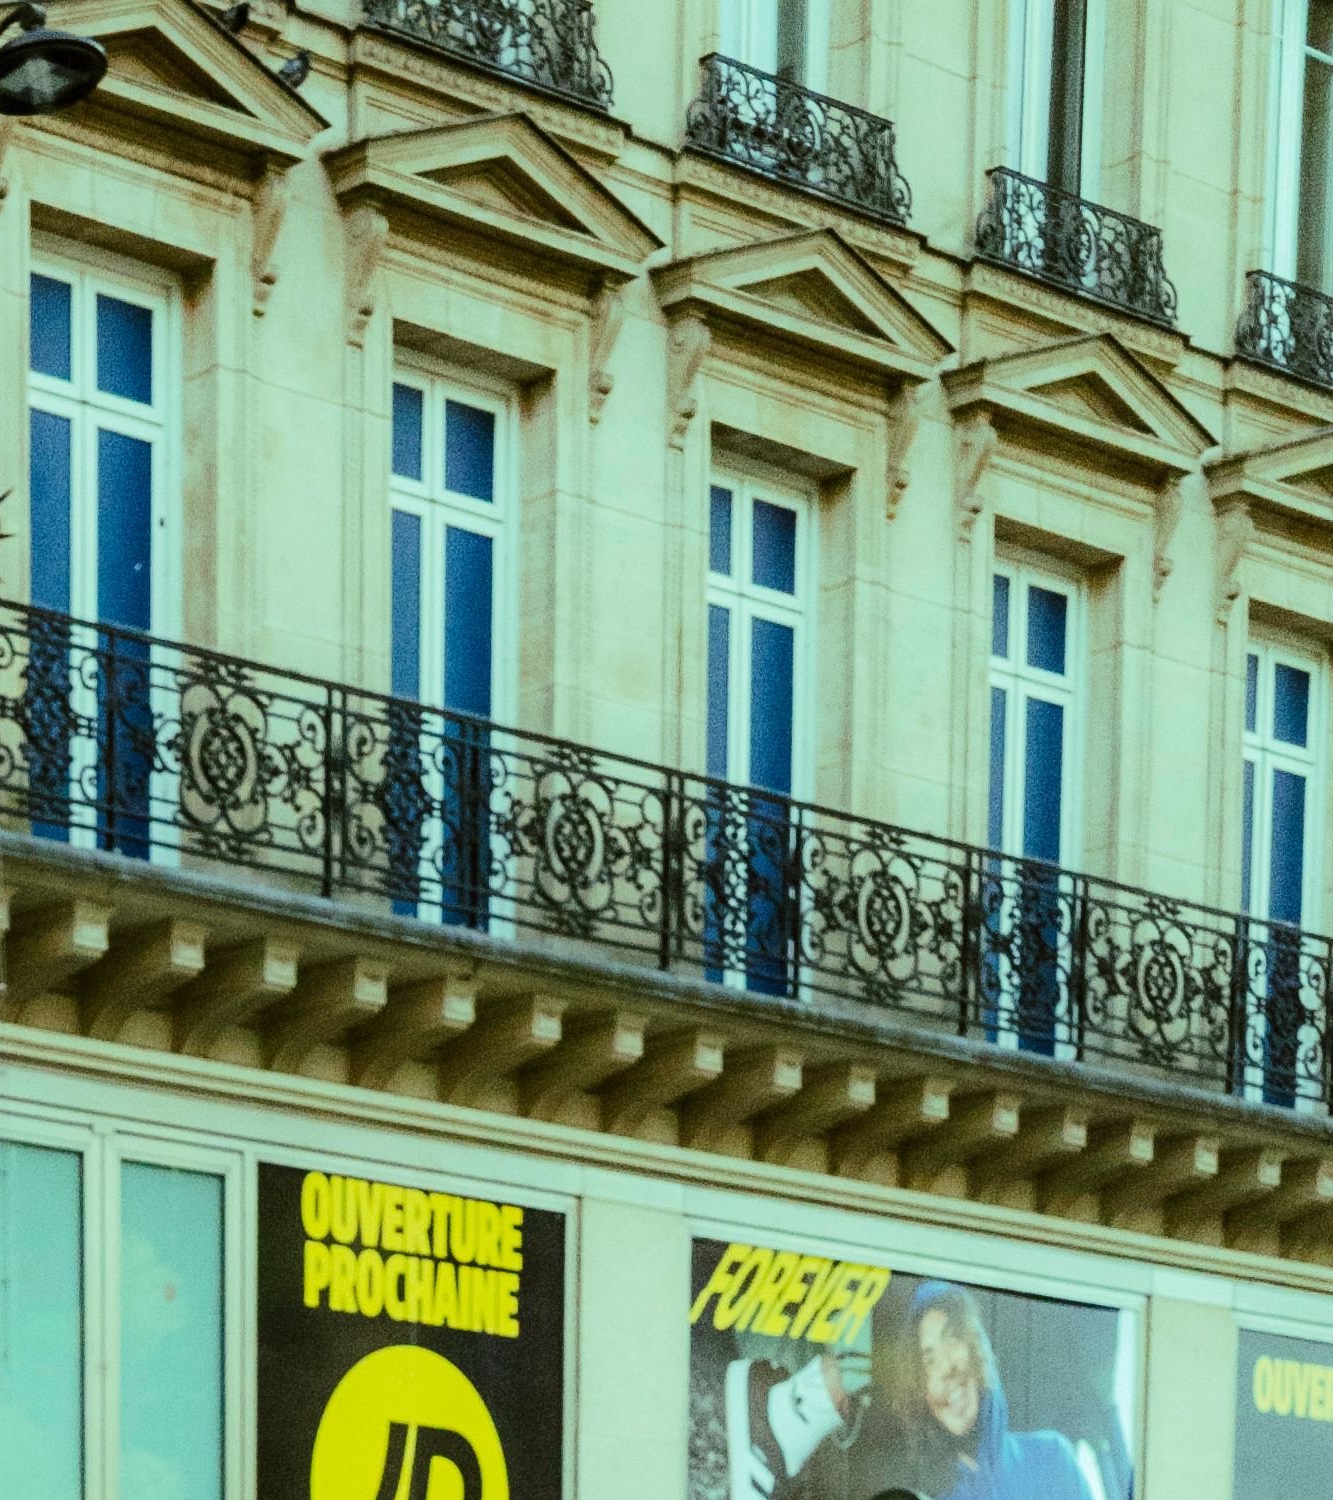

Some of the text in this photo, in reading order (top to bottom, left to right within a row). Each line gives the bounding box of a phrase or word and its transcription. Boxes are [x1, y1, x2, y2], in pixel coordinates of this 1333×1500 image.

[300, 1170, 524, 1271] OUVERTURE
[302, 1240, 520, 1338] PROCHAINE
[688, 1242, 892, 1345] FOREVER
